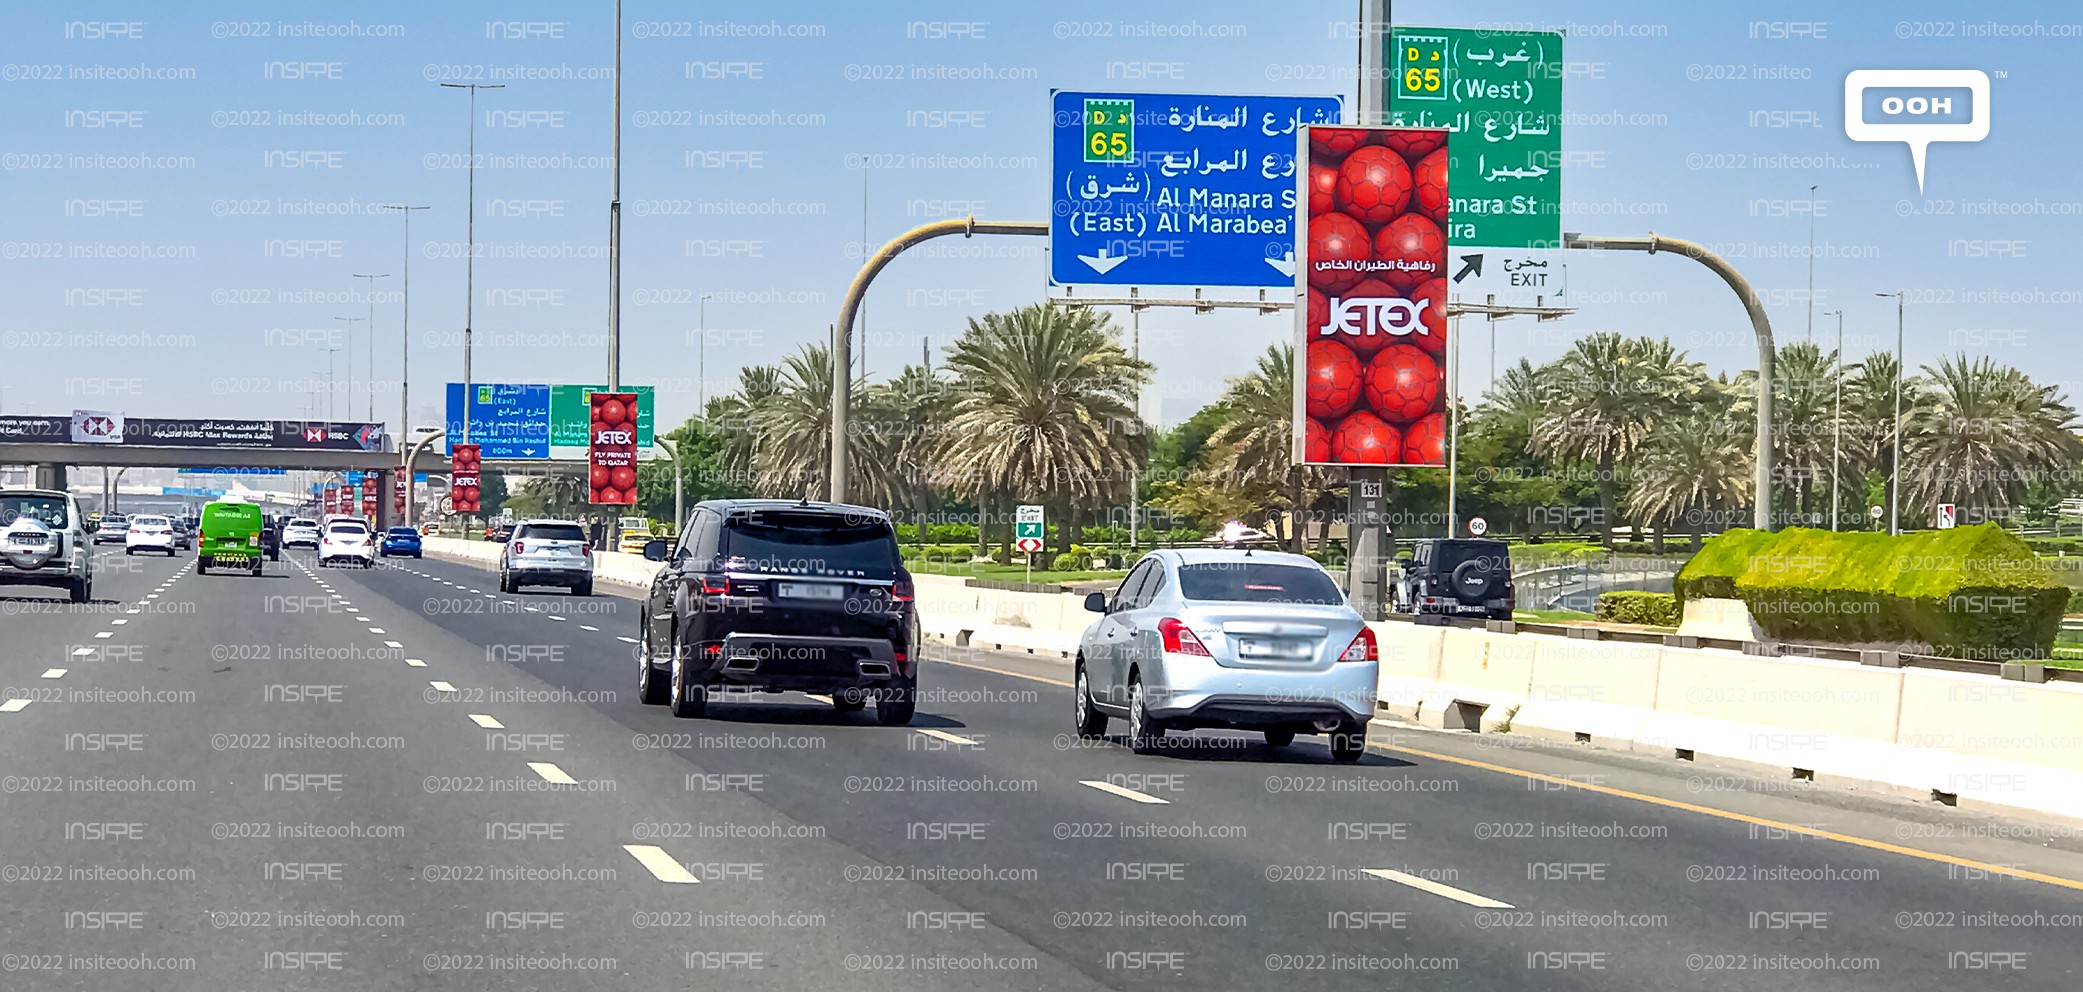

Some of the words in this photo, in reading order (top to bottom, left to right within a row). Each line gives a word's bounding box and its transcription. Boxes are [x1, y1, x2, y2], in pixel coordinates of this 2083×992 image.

[1408, 48, 1419, 61] D
[1405, 68, 1441, 92] 65
[1453, 78, 1533, 105] (West)
[1094, 111, 1104, 125] D
[1168, 105, 1248, 133] المنارة
[1484, 113, 1550, 142] شارع
[1090, 132, 1128, 157] 65
[1160, 148, 1248, 178] المرابع
[1478, 154, 1549, 182] جميرا
[1157, 188, 1180, 209] Al
[1189, 189, 1273, 210] Manara
[1282, 190, 1296, 209] S
[1511, 195, 1537, 215] St
[1069, 211, 1147, 238] (East)
[1156, 213, 1180, 233] Al
[1315, 260, 1353, 271] الخاص
[1354, 260, 1395, 272] الطيران
[1396, 259, 1436, 273] رفاهية
[1504, 256, 1548, 272] مخرج
[1511, 273, 1548, 287] EXIT
[1320, 297, 1430, 336] JETEX
[328, 432, 350, 440] HSBC
[595, 431, 632, 445] JETEX
[454, 477, 478, 486] JETEX
[1364, 485, 1380, 496] 131
[1471, 522, 1485, 531] 60
[760, 566, 808, 574] RANGE
[817, 568, 865, 576] ROVER
[1465, 577, 1484, 586] Jeep
